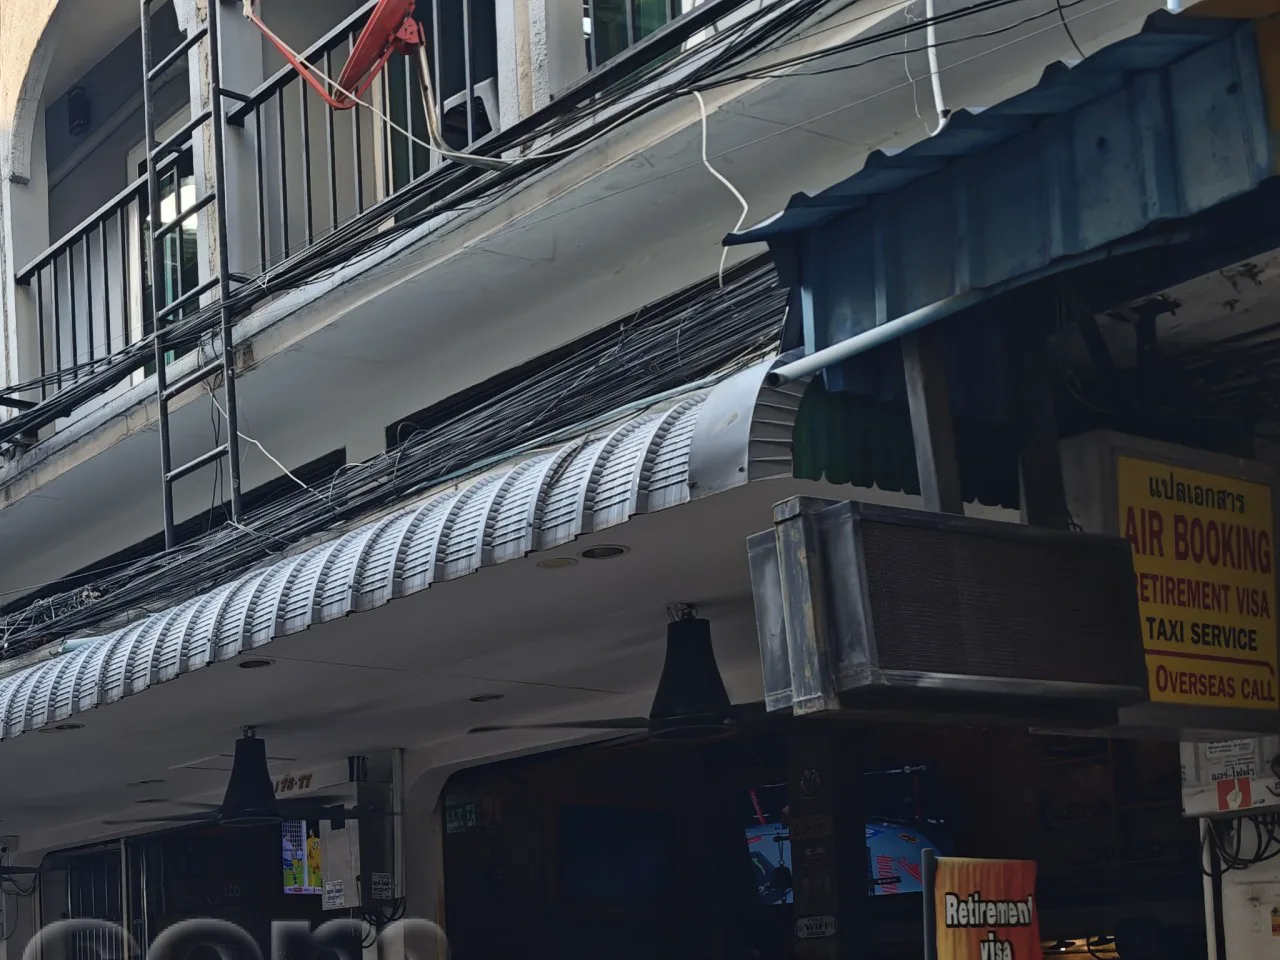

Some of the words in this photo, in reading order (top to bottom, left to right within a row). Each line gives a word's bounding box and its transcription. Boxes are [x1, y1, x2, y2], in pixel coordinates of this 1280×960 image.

[1149, 472, 1246, 514] แปลเอกสาร
[1124, 506, 1164, 558] AIR
[1174, 514, 1272, 575] BOOKING
[1136, 572, 1230, 614] ETIREMENT
[1236, 587, 1270, 619] VISA
[1146, 616, 1184, 644] TAXI
[1190, 622, 1258, 652] SERVICE
[1156, 664, 1236, 699] OVERSEAS
[1241, 676, 1277, 702] CALL
[945, 891, 1034, 928] Retirement
